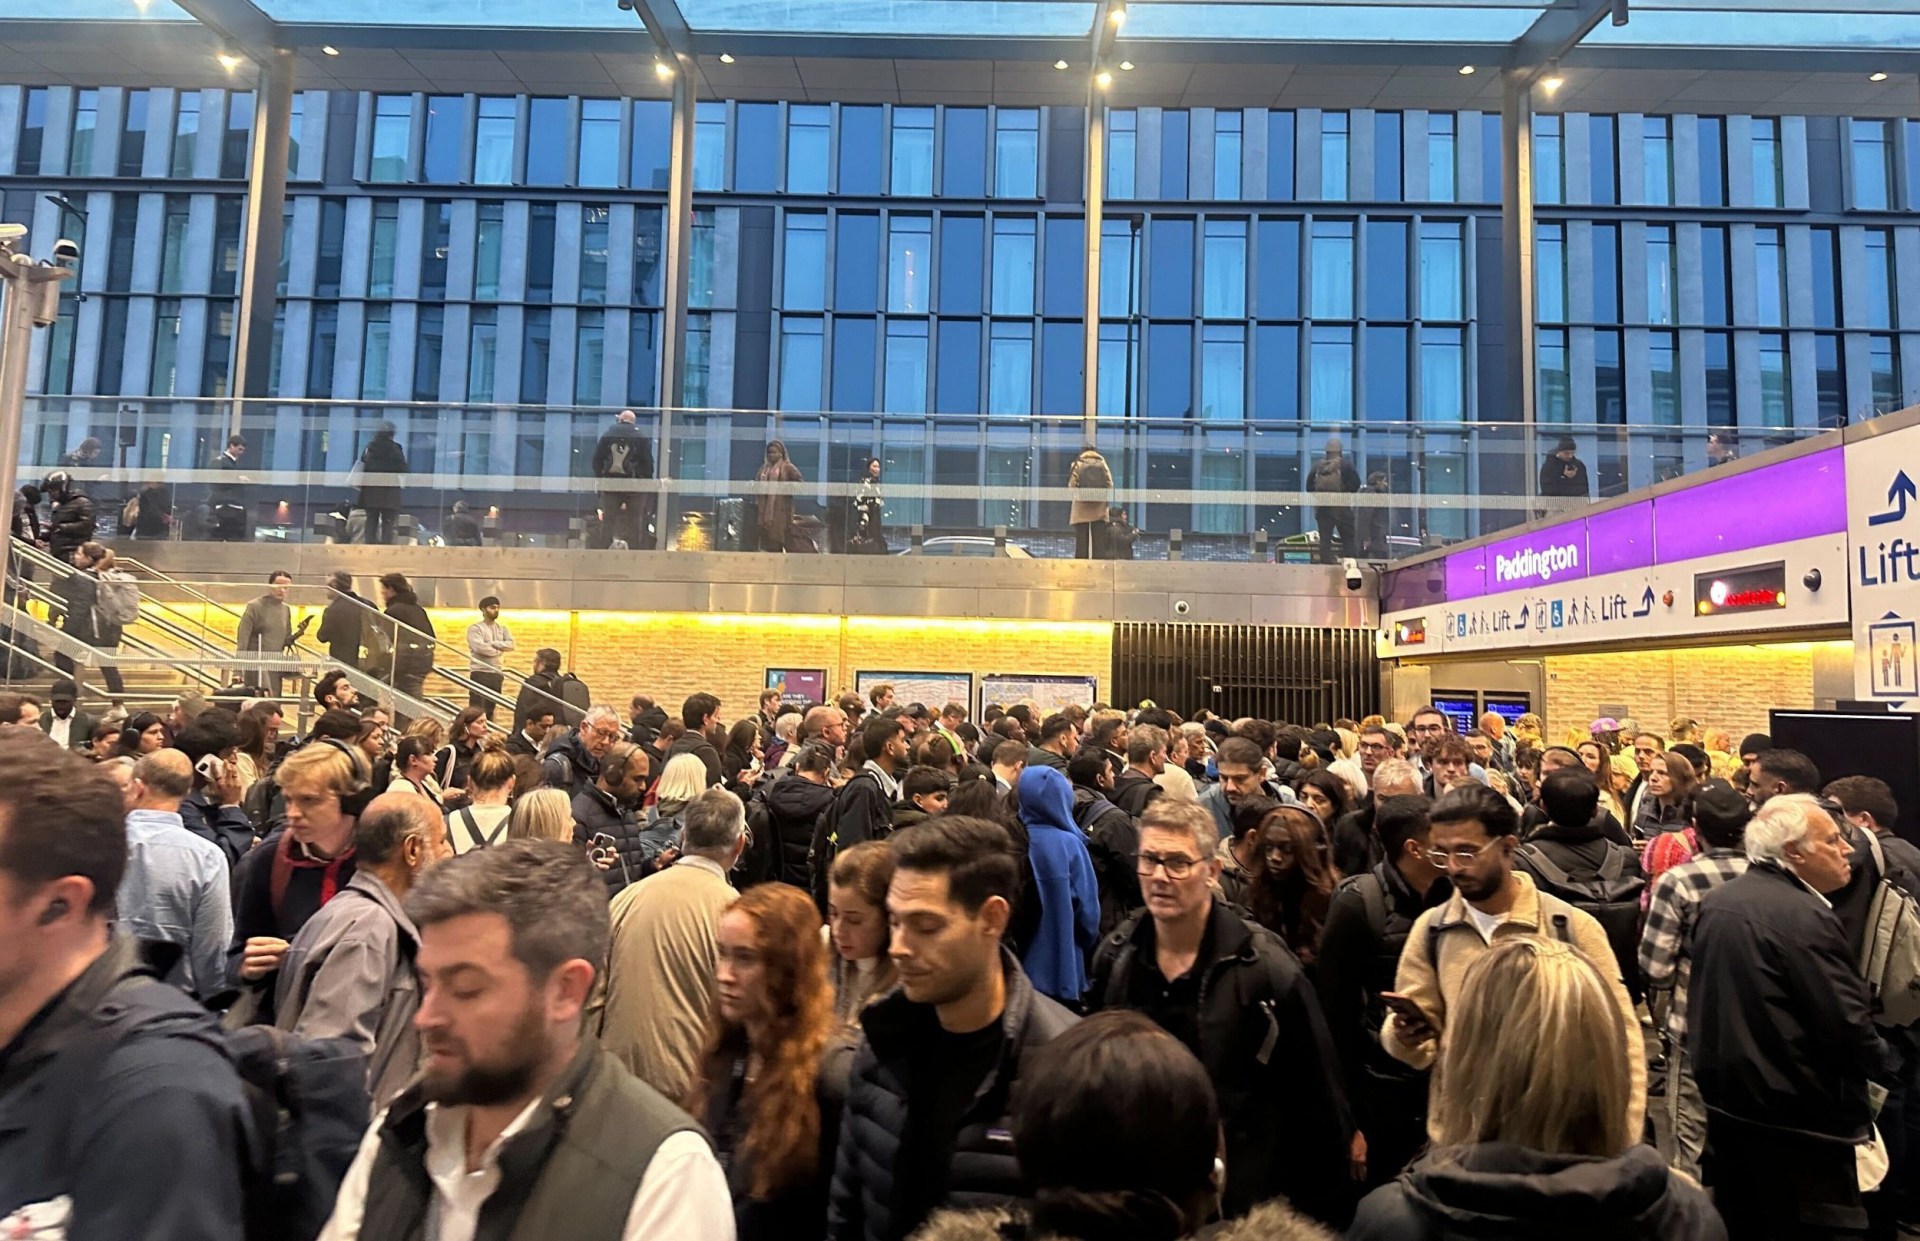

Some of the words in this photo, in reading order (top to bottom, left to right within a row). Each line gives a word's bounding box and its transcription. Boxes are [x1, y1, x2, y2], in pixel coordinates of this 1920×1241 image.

[1496, 544, 1578, 582] Paddington
[1859, 538, 1920, 586] Lift
[1493, 609, 1511, 632] Lift
[1601, 594, 1627, 620] Lift
